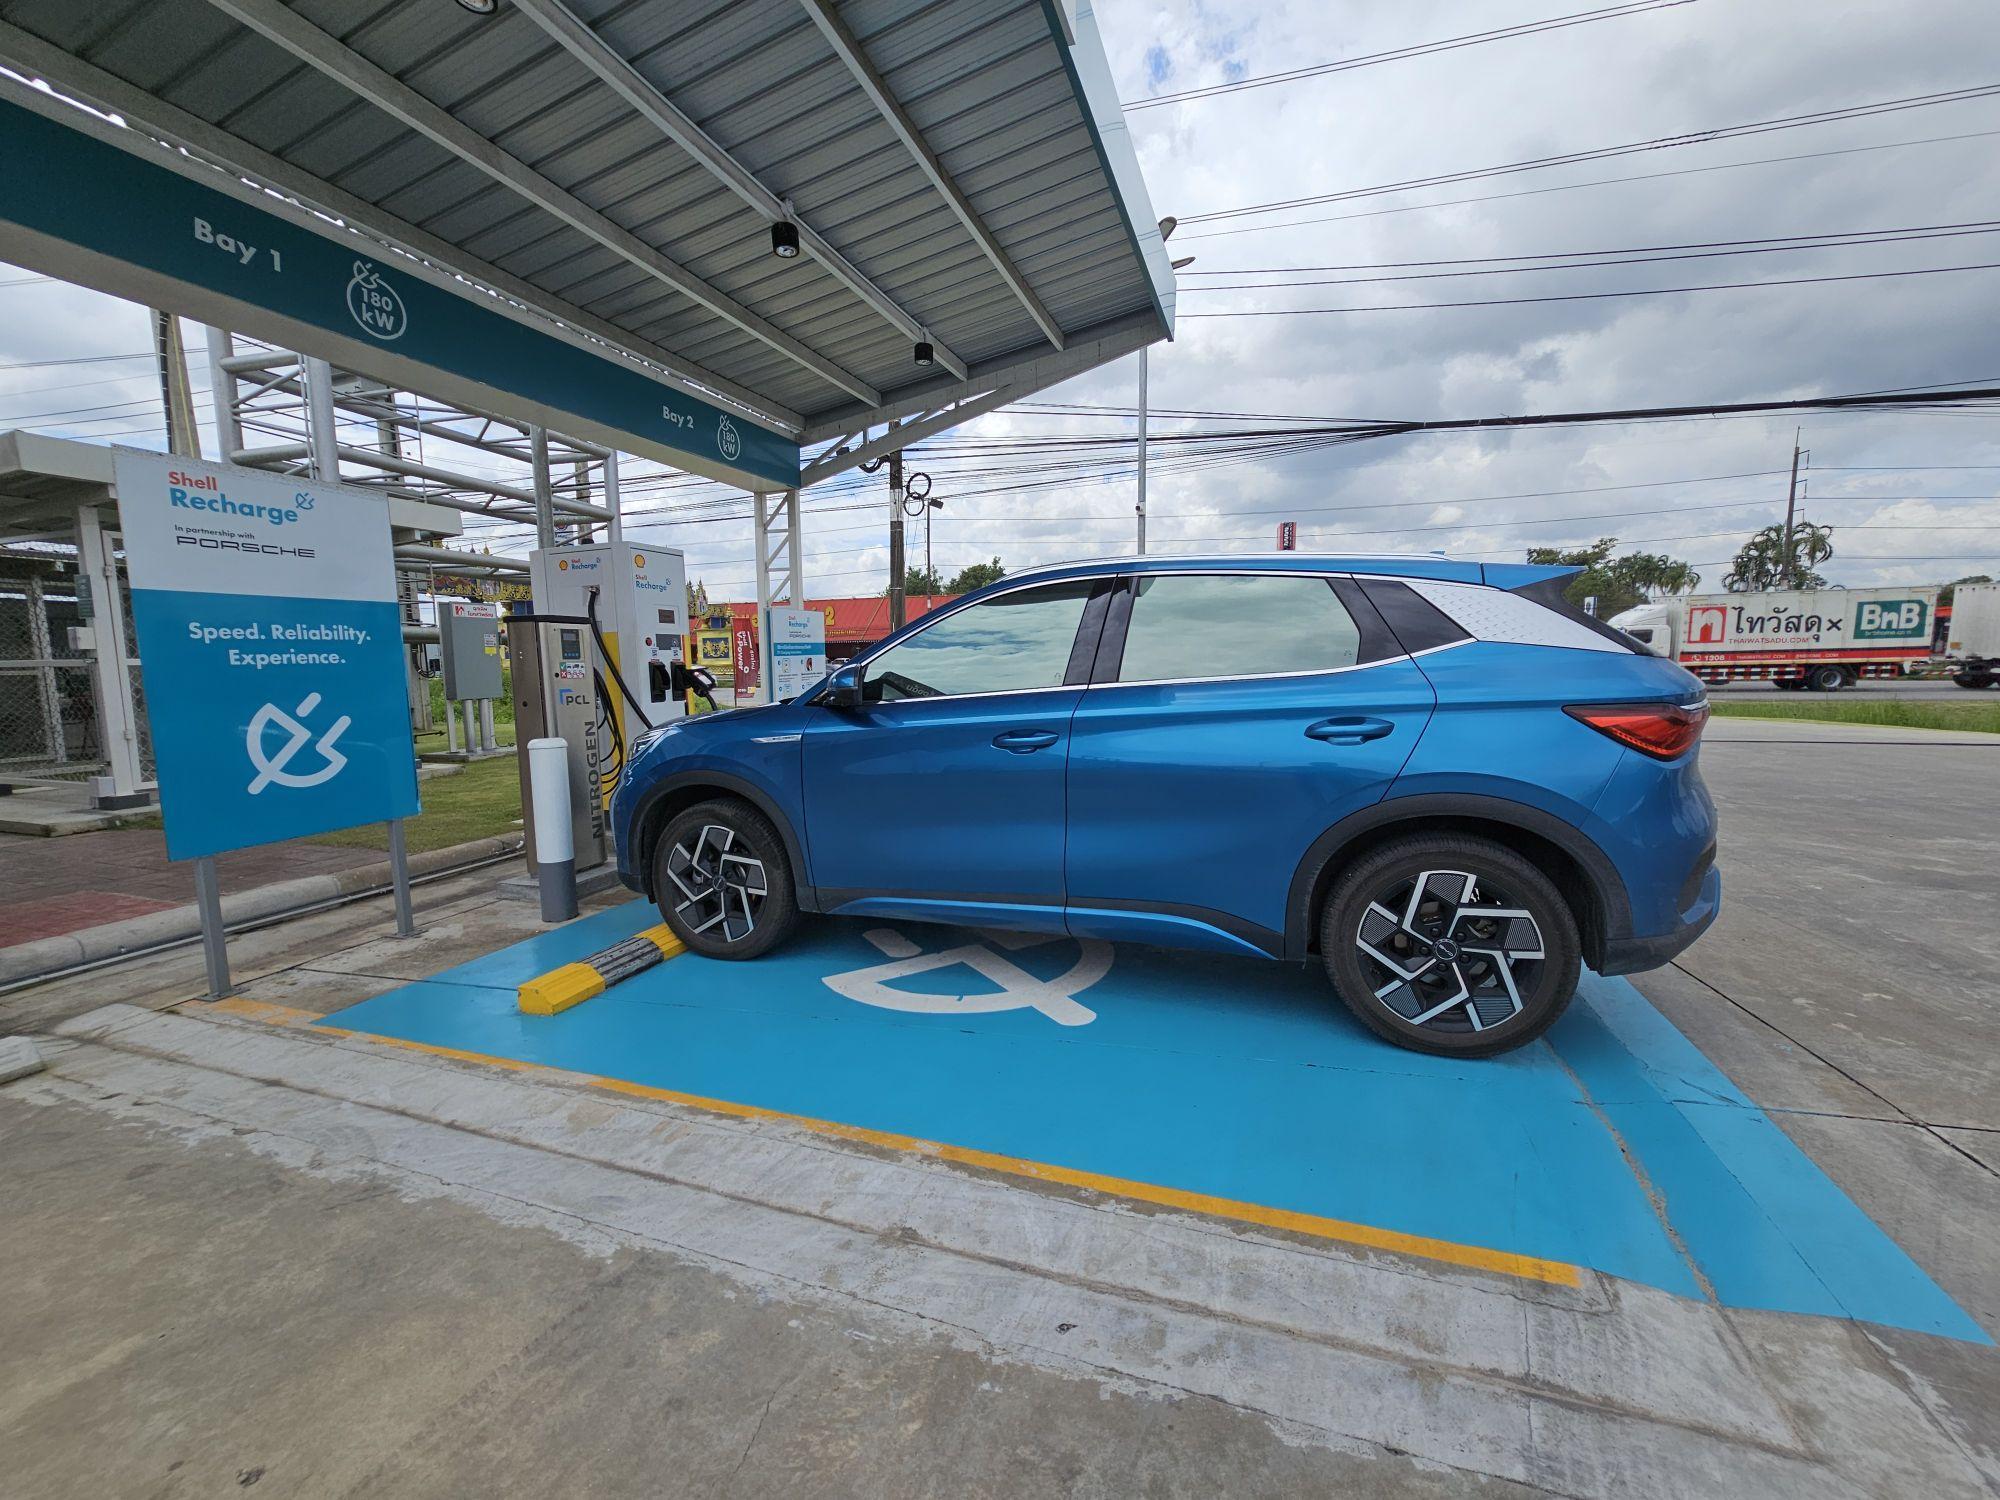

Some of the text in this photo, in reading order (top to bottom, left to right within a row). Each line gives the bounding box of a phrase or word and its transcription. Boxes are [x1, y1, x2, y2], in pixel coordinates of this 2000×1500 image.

[194, 217, 281, 273] Bay 1
[361, 287, 393, 312] 180
[361, 303, 394, 331] kW
[662, 405, 694, 429] Bay 2
[722, 430, 735, 443] 180
[722, 440, 735, 454] kW
[168, 471, 218, 491] Shell
[169, 487, 298, 525] Recharge
[174, 524, 255, 540] In partnership with
[176, 535, 316, 559] PORSCHE
[571, 562, 598, 571] Recharge
[635, 580, 667, 592] Recharge
[1731, 606, 1822, 643] ไทวัสดุ
[1861, 602, 1920, 630] BnB
[188, 622, 371, 645] Speed. Reliability.
[228, 648, 346, 670] Experience.
[565, 694, 590, 706] PCL
[584, 720, 602, 840] NITROGEN
